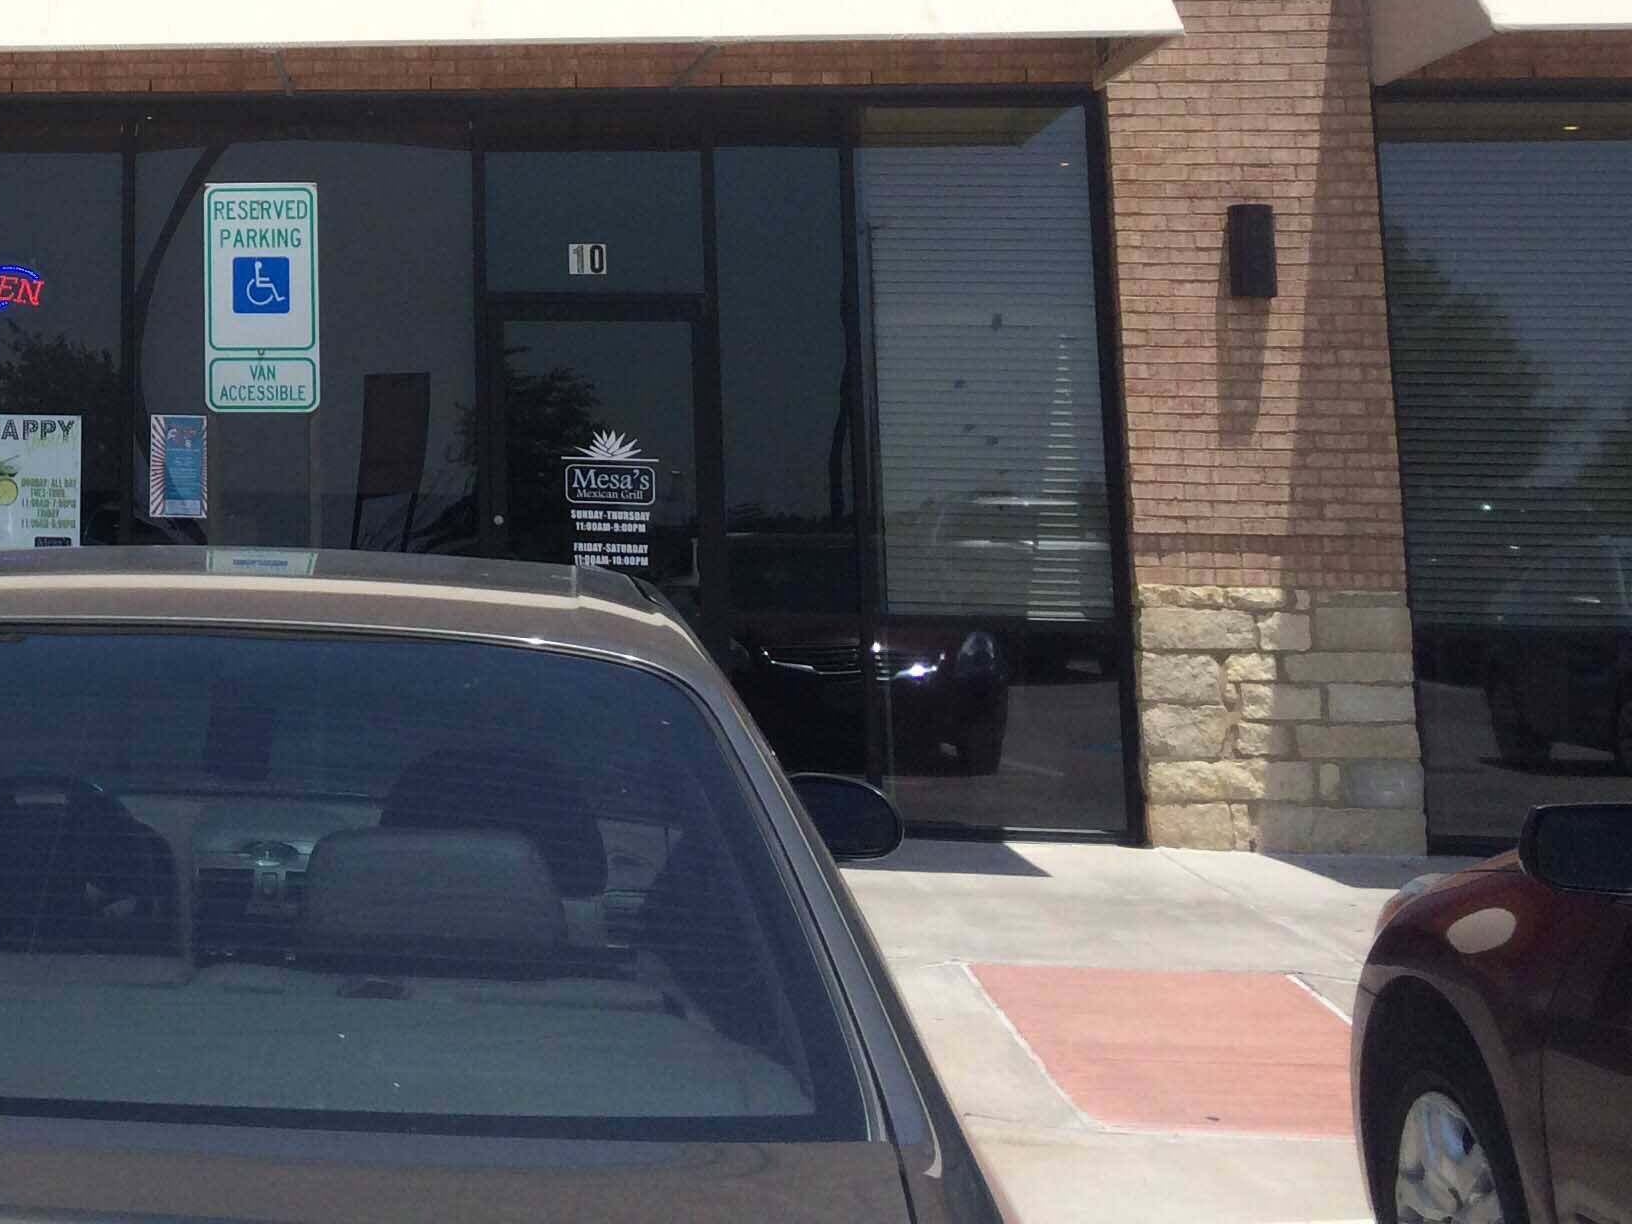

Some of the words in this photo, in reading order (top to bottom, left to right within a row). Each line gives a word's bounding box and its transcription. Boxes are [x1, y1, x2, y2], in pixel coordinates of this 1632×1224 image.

[213, 199, 309, 220] RESERVED
[220, 227, 303, 249] PARKING
[572, 244, 604, 273] 10
[249, 364, 277, 382] VAN
[219, 384, 307, 402] ACCESSIBLE
[572, 469, 649, 489] Mesa's
[576, 489, 618, 498] Mexican
[620, 490, 643, 500] Grill
[571, 510, 650, 520] SUNDAY-THURSDAY
[576, 522, 646, 532] 11:00AM-9:00PM
[573, 543, 648, 553] FRIDAY-SATURDAY
[574, 555, 648, 566] 11:00AM-10:00PM
